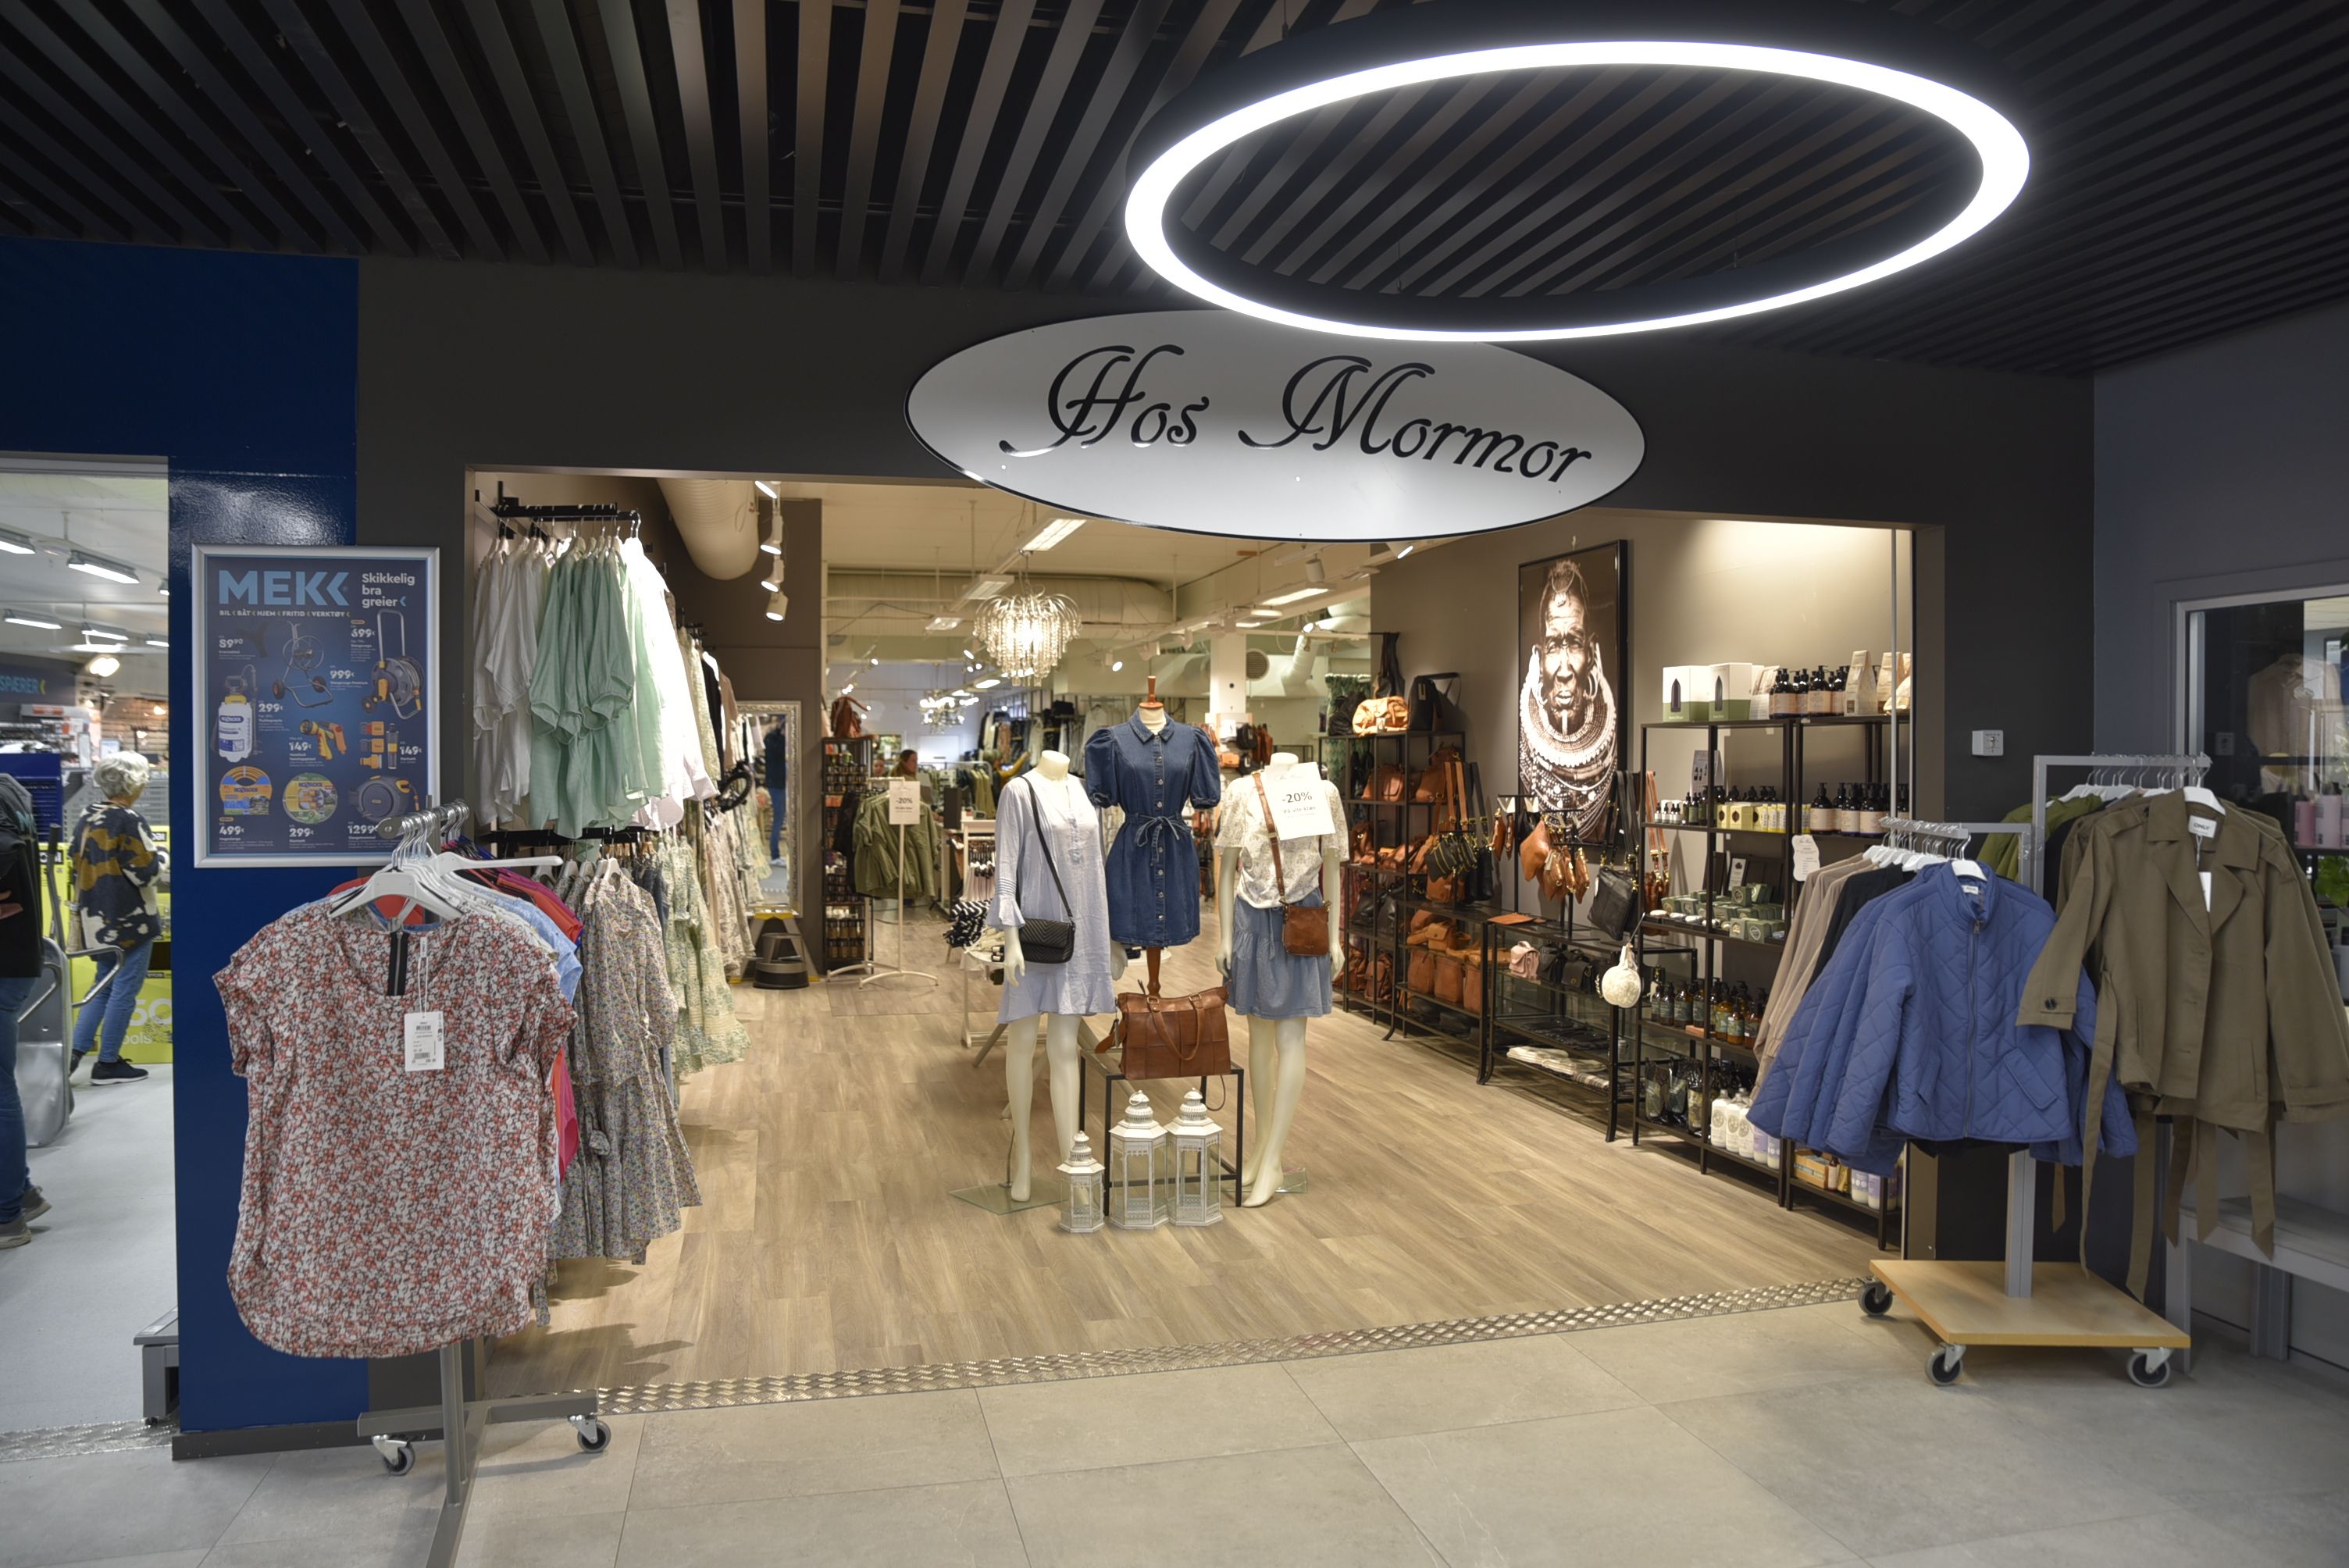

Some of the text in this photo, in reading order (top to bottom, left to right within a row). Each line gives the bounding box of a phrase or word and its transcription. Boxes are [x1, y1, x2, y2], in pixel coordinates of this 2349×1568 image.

[999, 344, 1592, 483] Hos Mormor
[362, 572, 415, 586] Skikkelig
[362, 584, 382, 595] bra
[362, 596, 398, 608] greier
[237, 608, 251, 617] BÅT
[330, 670, 351, 679] 999
[258, 703, 280, 712] 299
[288, 742, 308, 751] 149
[400, 746, 419, 755] 149
[1281, 791, 1313, 804] -20%
[219, 825, 241, 836] 499
[289, 828, 311, 837] 299
[348, 825, 375, 834] 1299
[122, 1032, 153, 1045] ools
